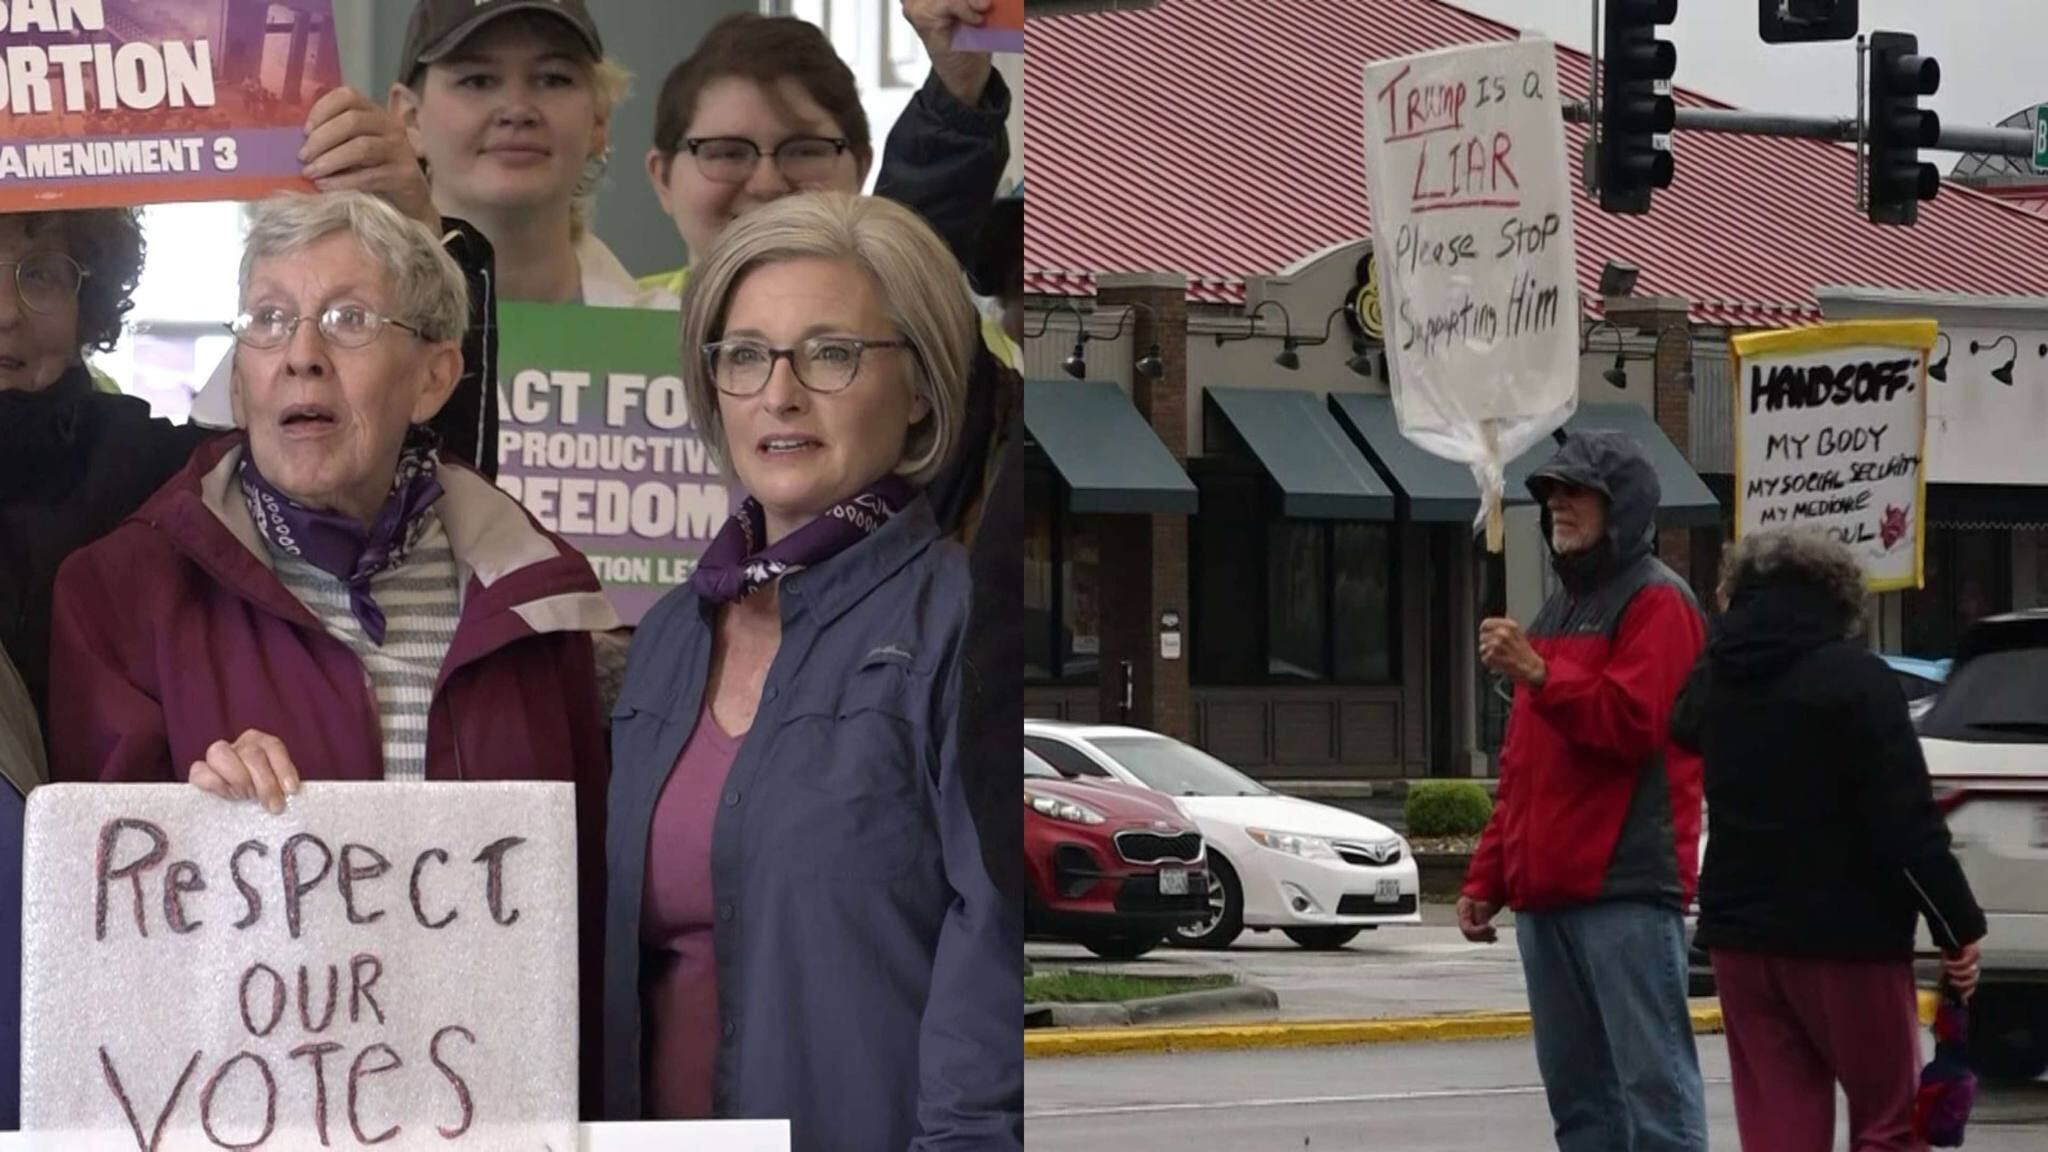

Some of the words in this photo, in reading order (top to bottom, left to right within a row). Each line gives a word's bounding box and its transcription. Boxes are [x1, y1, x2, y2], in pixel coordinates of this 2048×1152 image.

[0, 0, 104, 33] AN
[0, 40, 216, 114] RTION
[0, 138, 204, 179] AMENDMENT
[213, 136, 239, 170] 3
[1412, 131, 1518, 199] LIAR
[1396, 223, 1479, 274] Please
[1507, 270, 1559, 337] Him
[606, 373, 697, 429] FO
[1766, 433, 1810, 460] MY
[1816, 424, 1888, 456] BODY
[1760, 507, 1788, 526] MY
[658, 558, 697, 584] LE
[238, 952, 385, 1036] OUR
